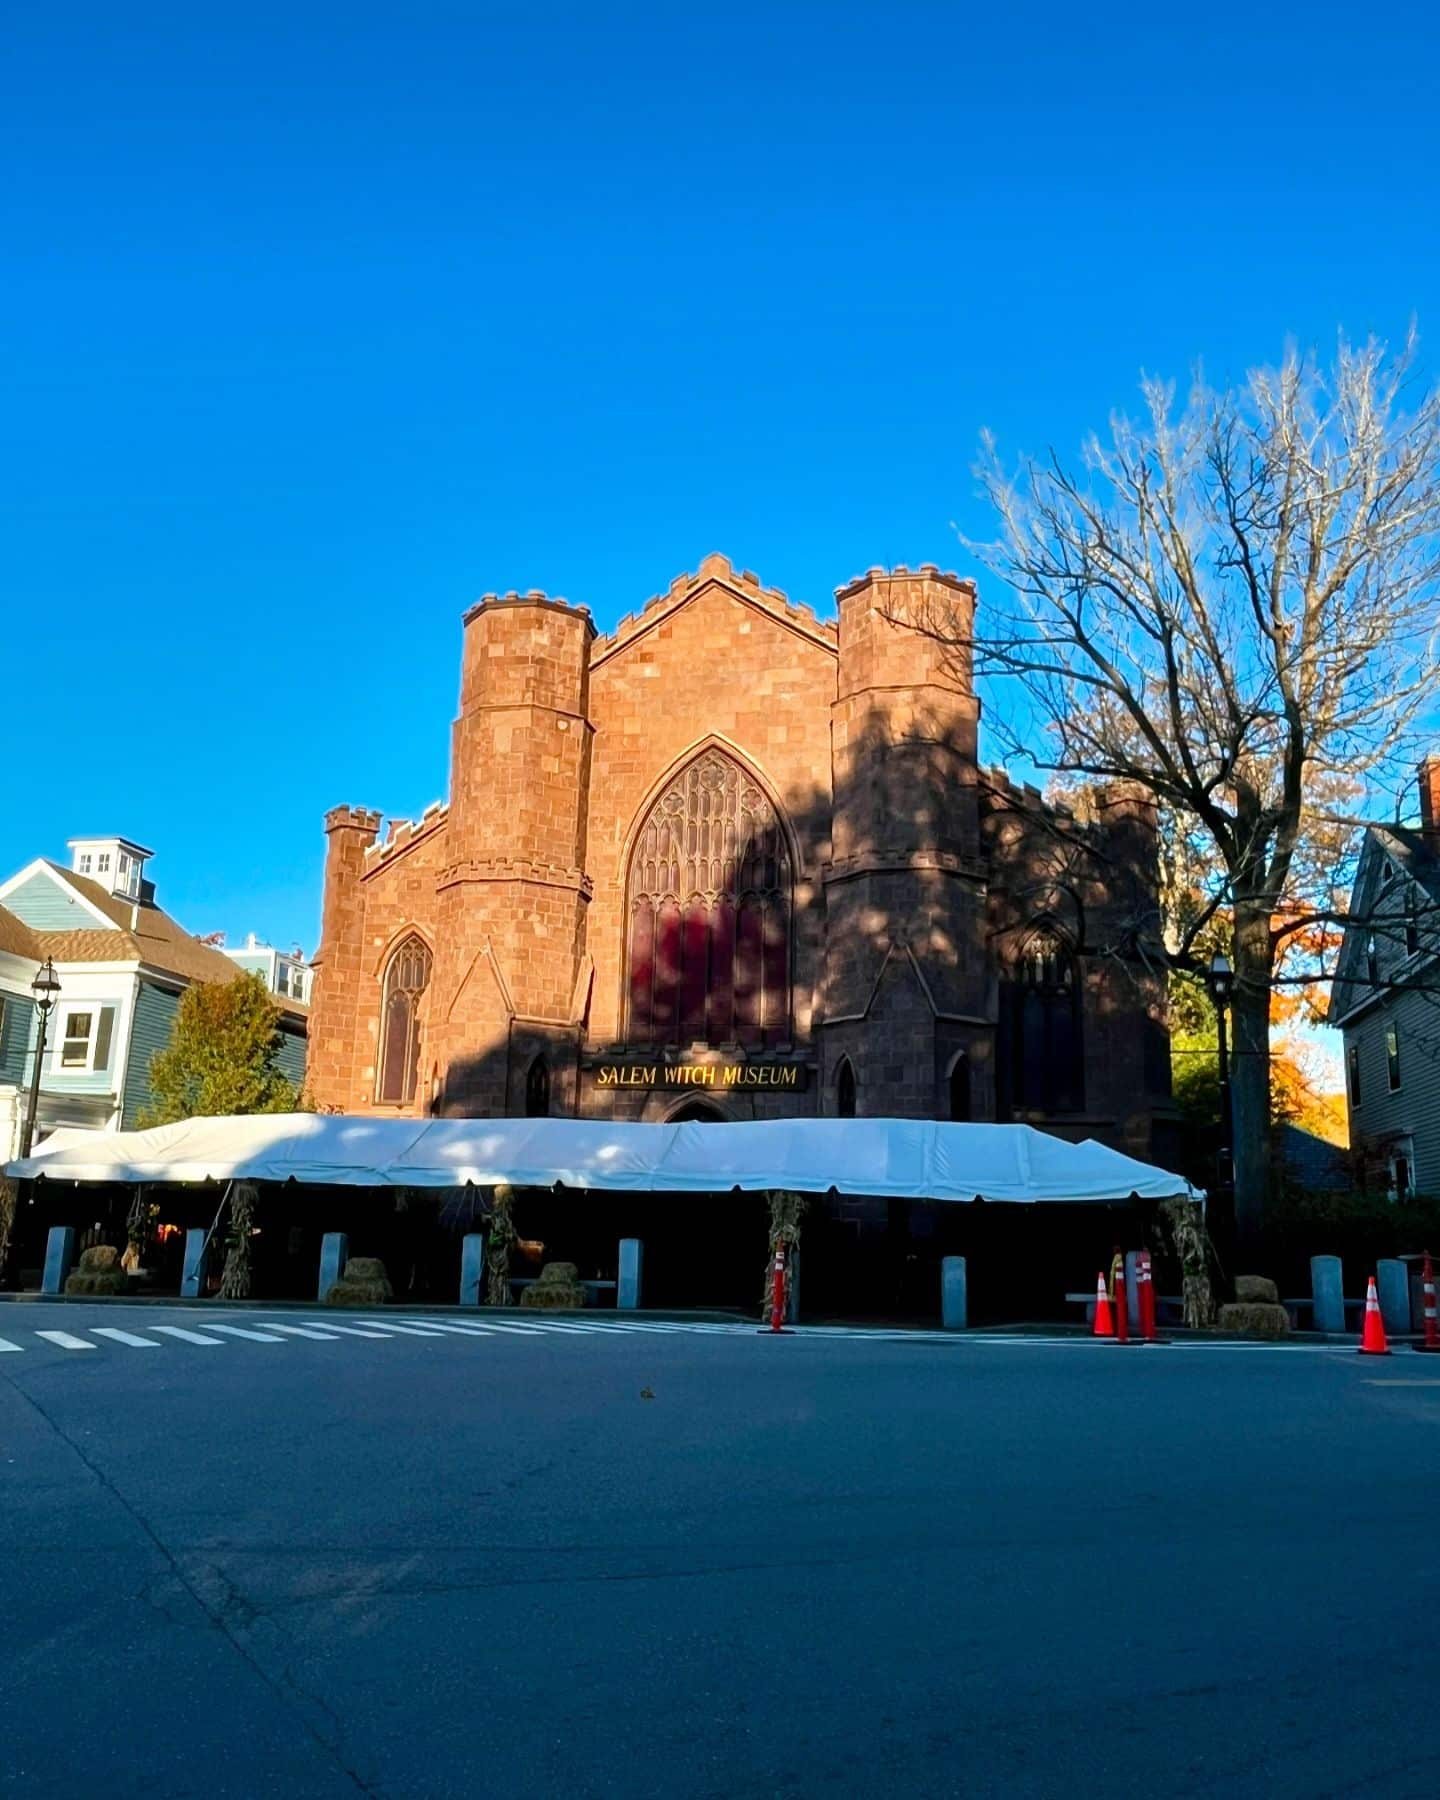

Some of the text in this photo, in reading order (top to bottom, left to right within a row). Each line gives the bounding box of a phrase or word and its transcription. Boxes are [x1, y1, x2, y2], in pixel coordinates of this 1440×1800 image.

[598, 1066, 797, 1085] SALEM WITCH MUSEUM
